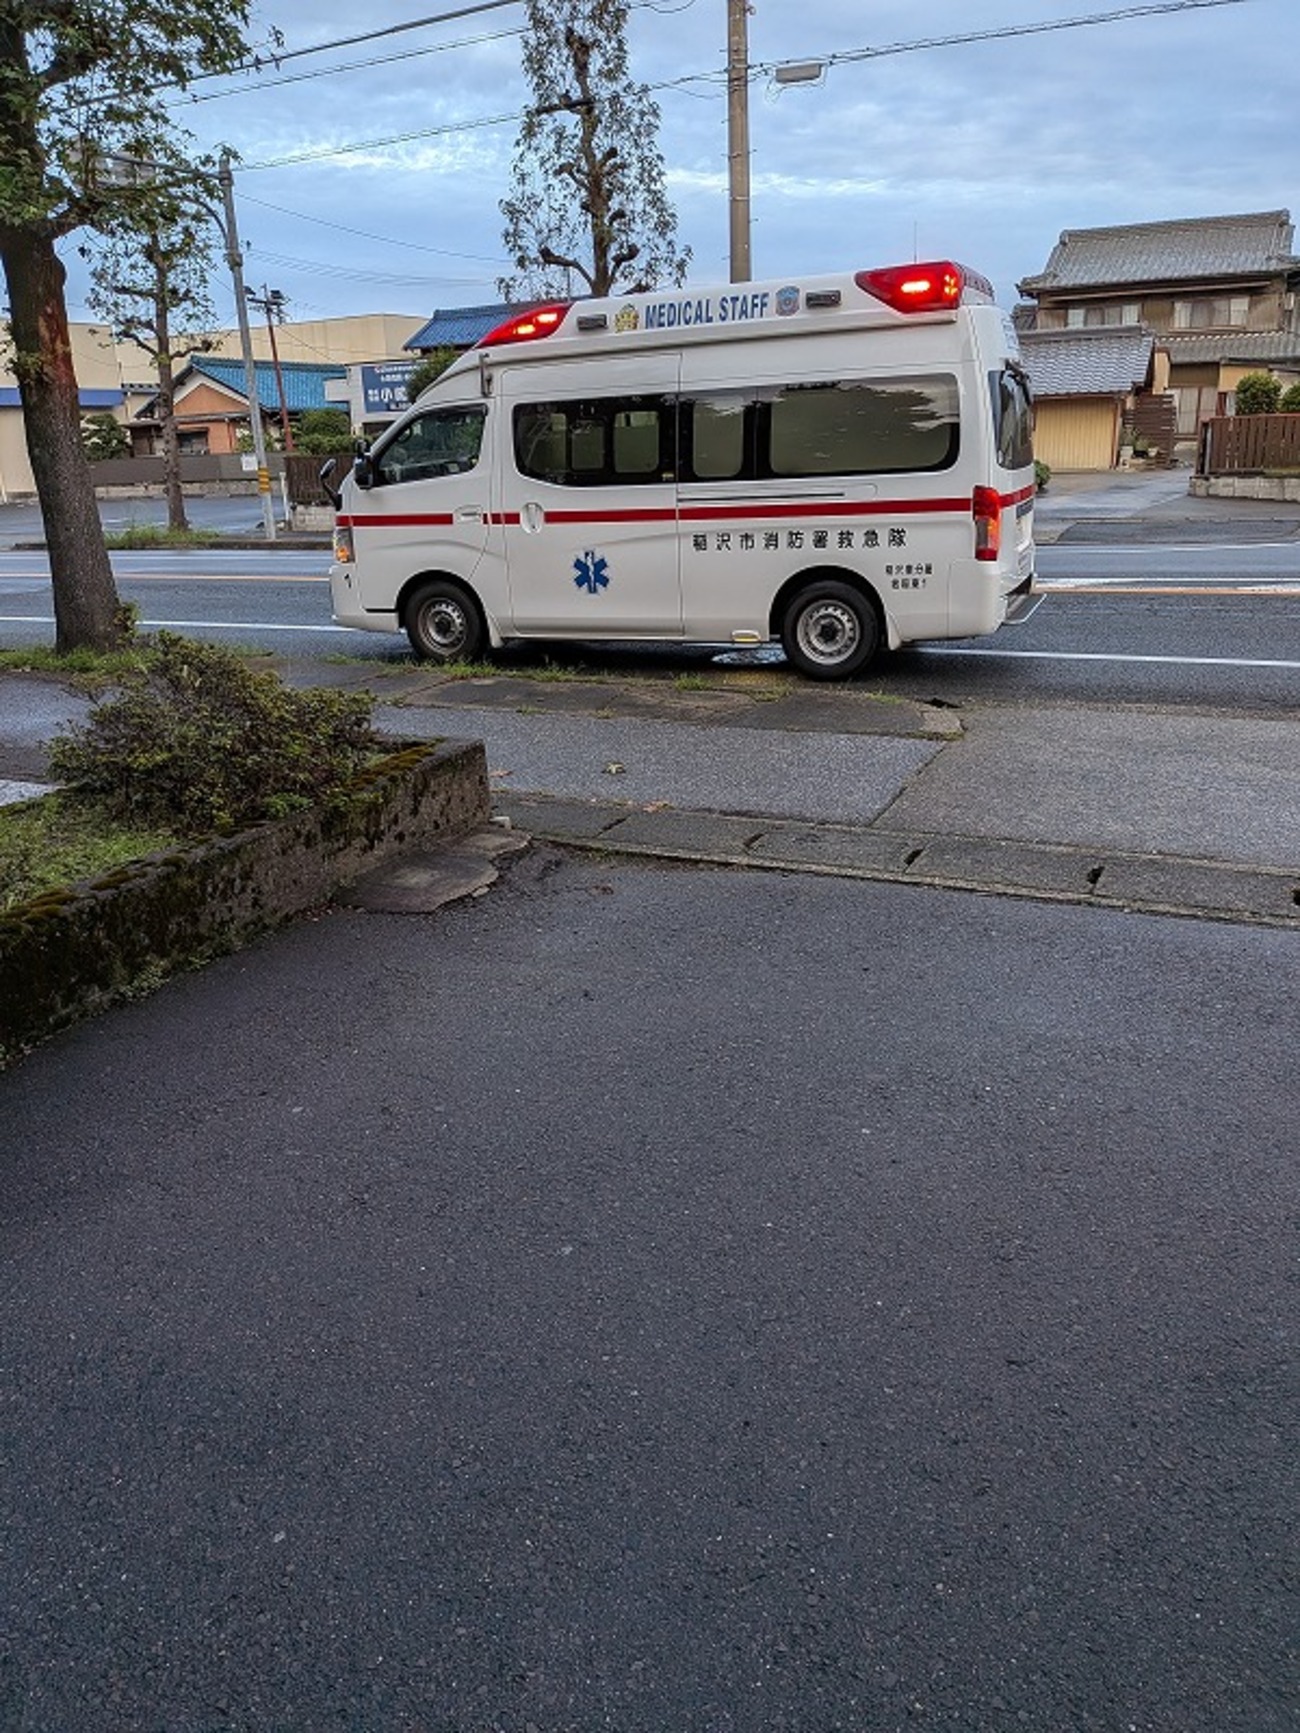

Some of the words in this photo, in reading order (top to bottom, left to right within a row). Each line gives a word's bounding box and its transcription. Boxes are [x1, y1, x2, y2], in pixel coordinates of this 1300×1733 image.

[645, 299, 714, 330] MEDICAL
[719, 292, 770, 321] STAFF
[692, 527, 907, 551] 稲沢市消防署救急隊
